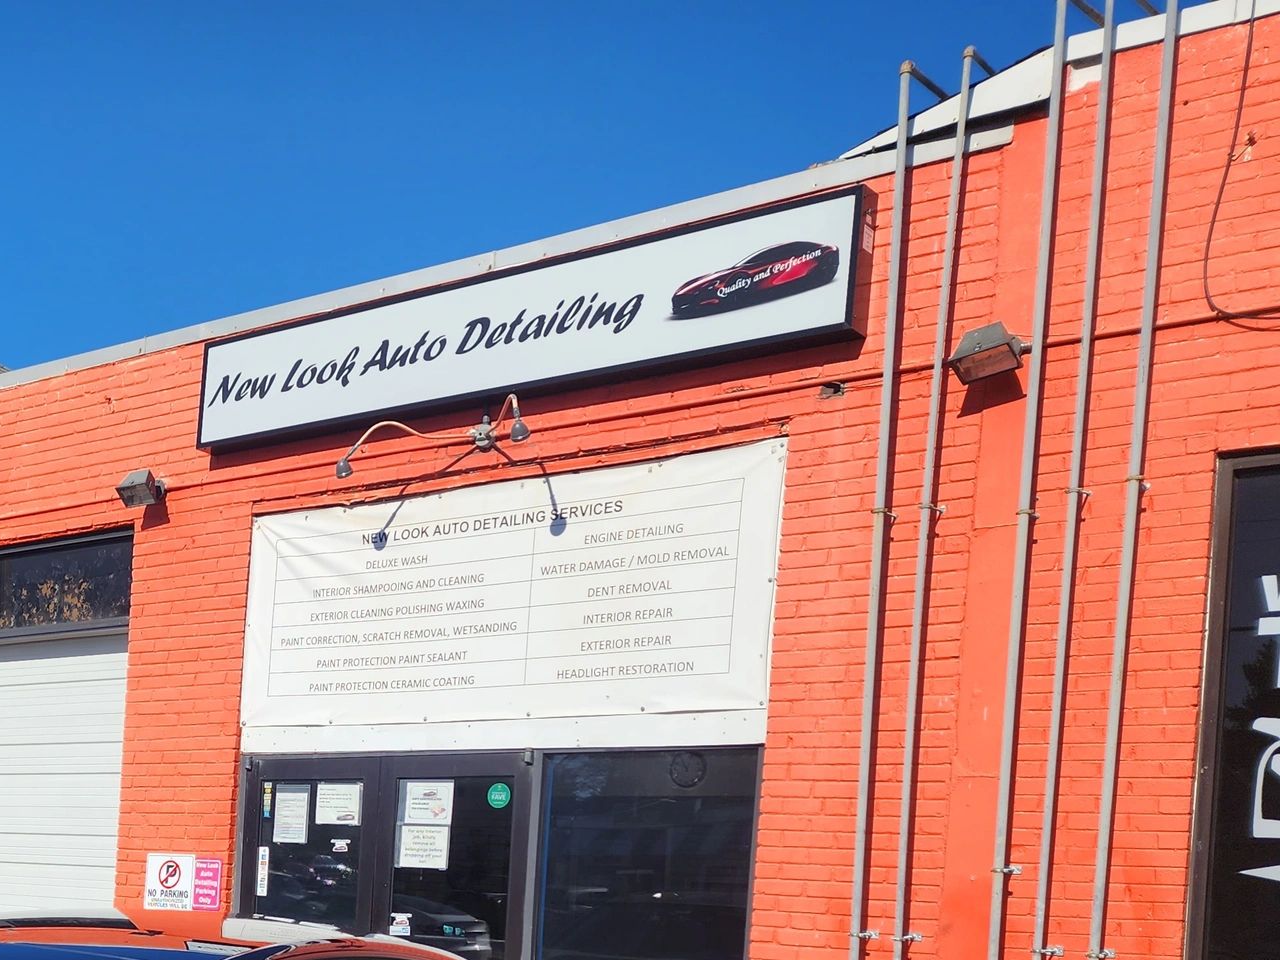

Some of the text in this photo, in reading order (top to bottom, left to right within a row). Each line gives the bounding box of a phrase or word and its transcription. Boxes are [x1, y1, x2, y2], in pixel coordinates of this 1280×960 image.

[717, 248, 822, 298] Quality and Perfection
[207, 292, 645, 408] New Look Auto Detailing
[362, 500, 623, 545] NEW LOOK AUTO DETAILING SERVICES
[584, 523, 684, 545] ENGINE DETAILING
[365, 555, 428, 570] DELUXE WASH
[540, 545, 730, 576] WATER DAMAGE / MOLD REMOVAL
[312, 573, 485, 598] INTERIOR SHAMPOOING AND CLEANING
[587, 579, 672, 598] DENT REMOVAL
[310, 598, 485, 622] EXTERIOR CLEANING POLISHING WAXING
[583, 607, 673, 625] INTERIOR REPAIR
[280, 621, 517, 647] PAINT CORRECTION, SCRATCH REMOVAL, WETSANDING
[580, 635, 672, 652] EXTERIOR REPAIR
[316, 650, 468, 669] PAINT PROTECTION PAINT SEALANT
[557, 661, 695, 679] HEADLIGHT RESTORATION
[309, 675, 475, 692] PAINT PROTECTION CERAMIC COATING
[194, 879, 218, 888] Detailing
[195, 888, 216, 896] Parking
[147, 889, 189, 898] NO PARKING
[198, 897, 212, 905] Only
